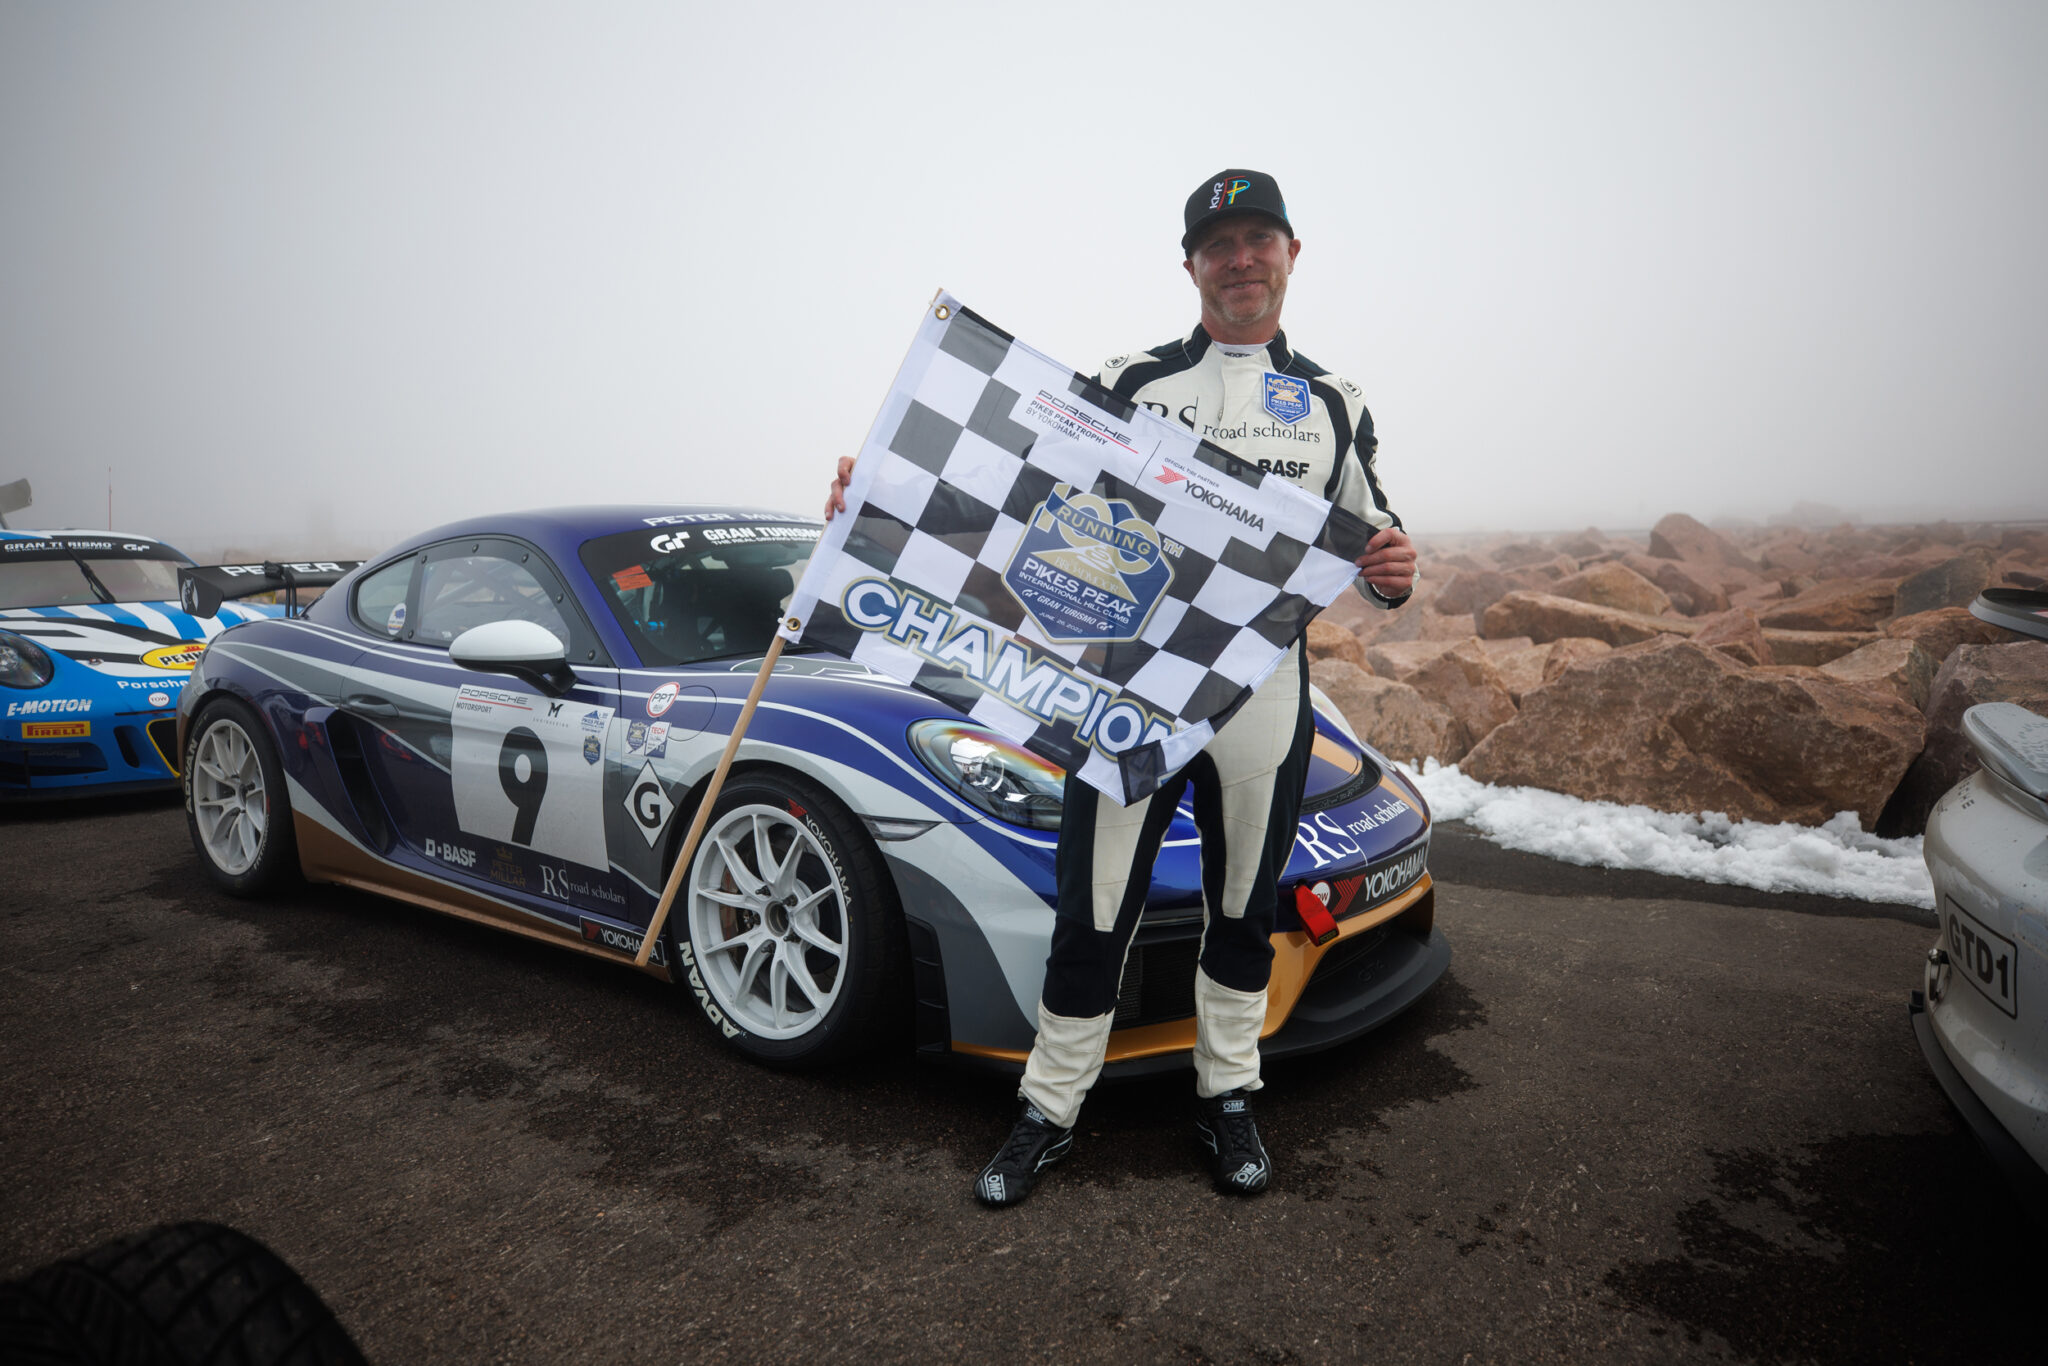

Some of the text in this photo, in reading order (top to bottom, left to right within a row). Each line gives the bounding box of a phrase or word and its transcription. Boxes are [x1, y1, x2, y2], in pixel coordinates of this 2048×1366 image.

[1209, 182, 1224, 209] KMR
[1025, 408, 1081, 441] BY YOKOHAMA
[1030, 400, 1109, 446] PIKES PEAK TROPHY
[1037, 389, 1133, 446] PORSCHE
[1253, 422, 1321, 443] scholars
[1164, 457, 1186, 472] OFFICIAL
[1257, 459, 1310, 479] BASF
[1183, 479, 1265, 532] YOKOHAMA
[643, 513, 736, 527] PETER
[1056, 505, 1151, 556] RUNNING
[4, 542, 45, 550] GRAN
[702, 527, 757, 541] GRAN
[220, 561, 345, 577] PEER
[1018, 571, 1130, 625] INTERNATIONAL HILL CLIMB
[1021, 557, 1136, 617] PIKES PEAK
[1037, 595, 1061, 610] GRAN
[1061, 604, 1097, 625] TURISMO
[117, 679, 189, 689] Porsche
[460, 687, 528, 705] PORSCHE
[651, 692, 675, 703] PPT
[7, 699, 92, 717] E-MOTION
[455, 701, 493, 714] MOTORSPORT
[27, 724, 85, 737] PIRELLI
[185, 738, 198, 813] ADVAN
[498, 726, 549, 847] 9
[634, 782, 661, 829] G
[1347, 811, 1380, 836] road
[1374, 799, 1411, 825] scholars
[443, 842, 477, 868] BASF
[492, 860, 523, 877] PETER
[805, 815, 852, 906] YOKOHAMA
[490, 869, 527, 888] MILLAR
[539, 863, 626, 905] RS road scholars
[1365, 846, 1426, 902] YOKOHAMA
[600, 928, 660, 961] YOKOHAA
[1949, 913, 2008, 999] GTD1
[679, 941, 741, 1039] ADVAN
[1027, 1107, 1046, 1121] OMP
[1223, 1101, 1245, 1112] OMP
[1236, 1163, 1258, 1183] OMP
[988, 1174, 1003, 1201] OMP
